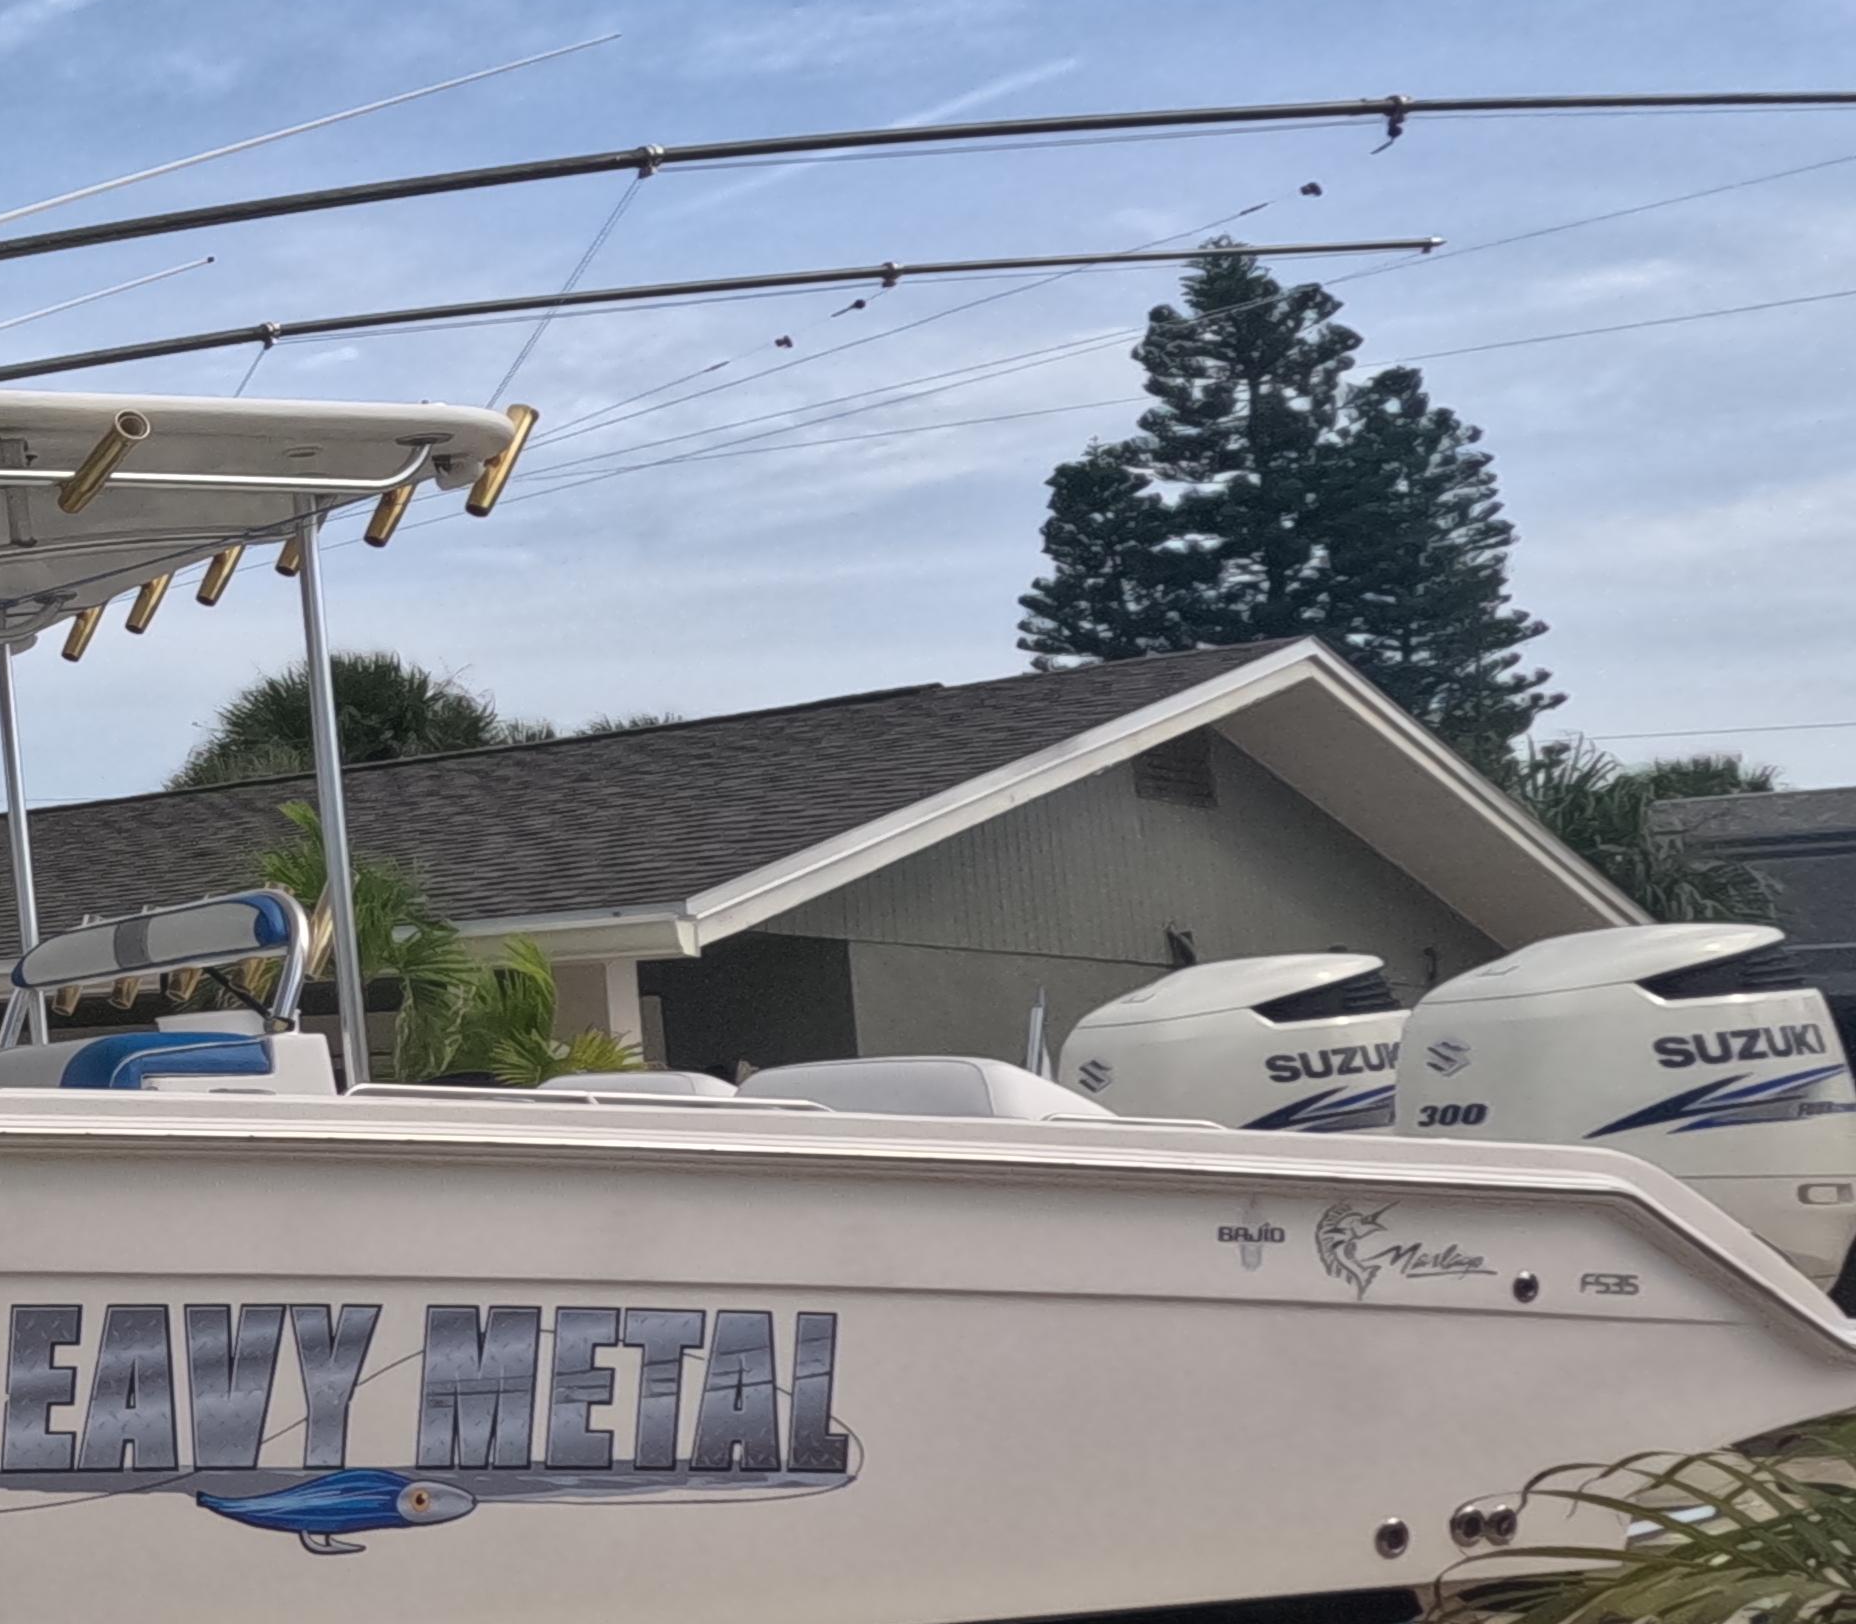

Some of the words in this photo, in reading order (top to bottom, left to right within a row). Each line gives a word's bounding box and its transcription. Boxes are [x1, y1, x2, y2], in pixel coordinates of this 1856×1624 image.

[1652, 1023, 1826, 1068] SUZUKI
[1417, 1102, 1488, 1128] 300
[1580, 1273, 1640, 1295] FS35
[415, 1305, 849, 1474] METAL
